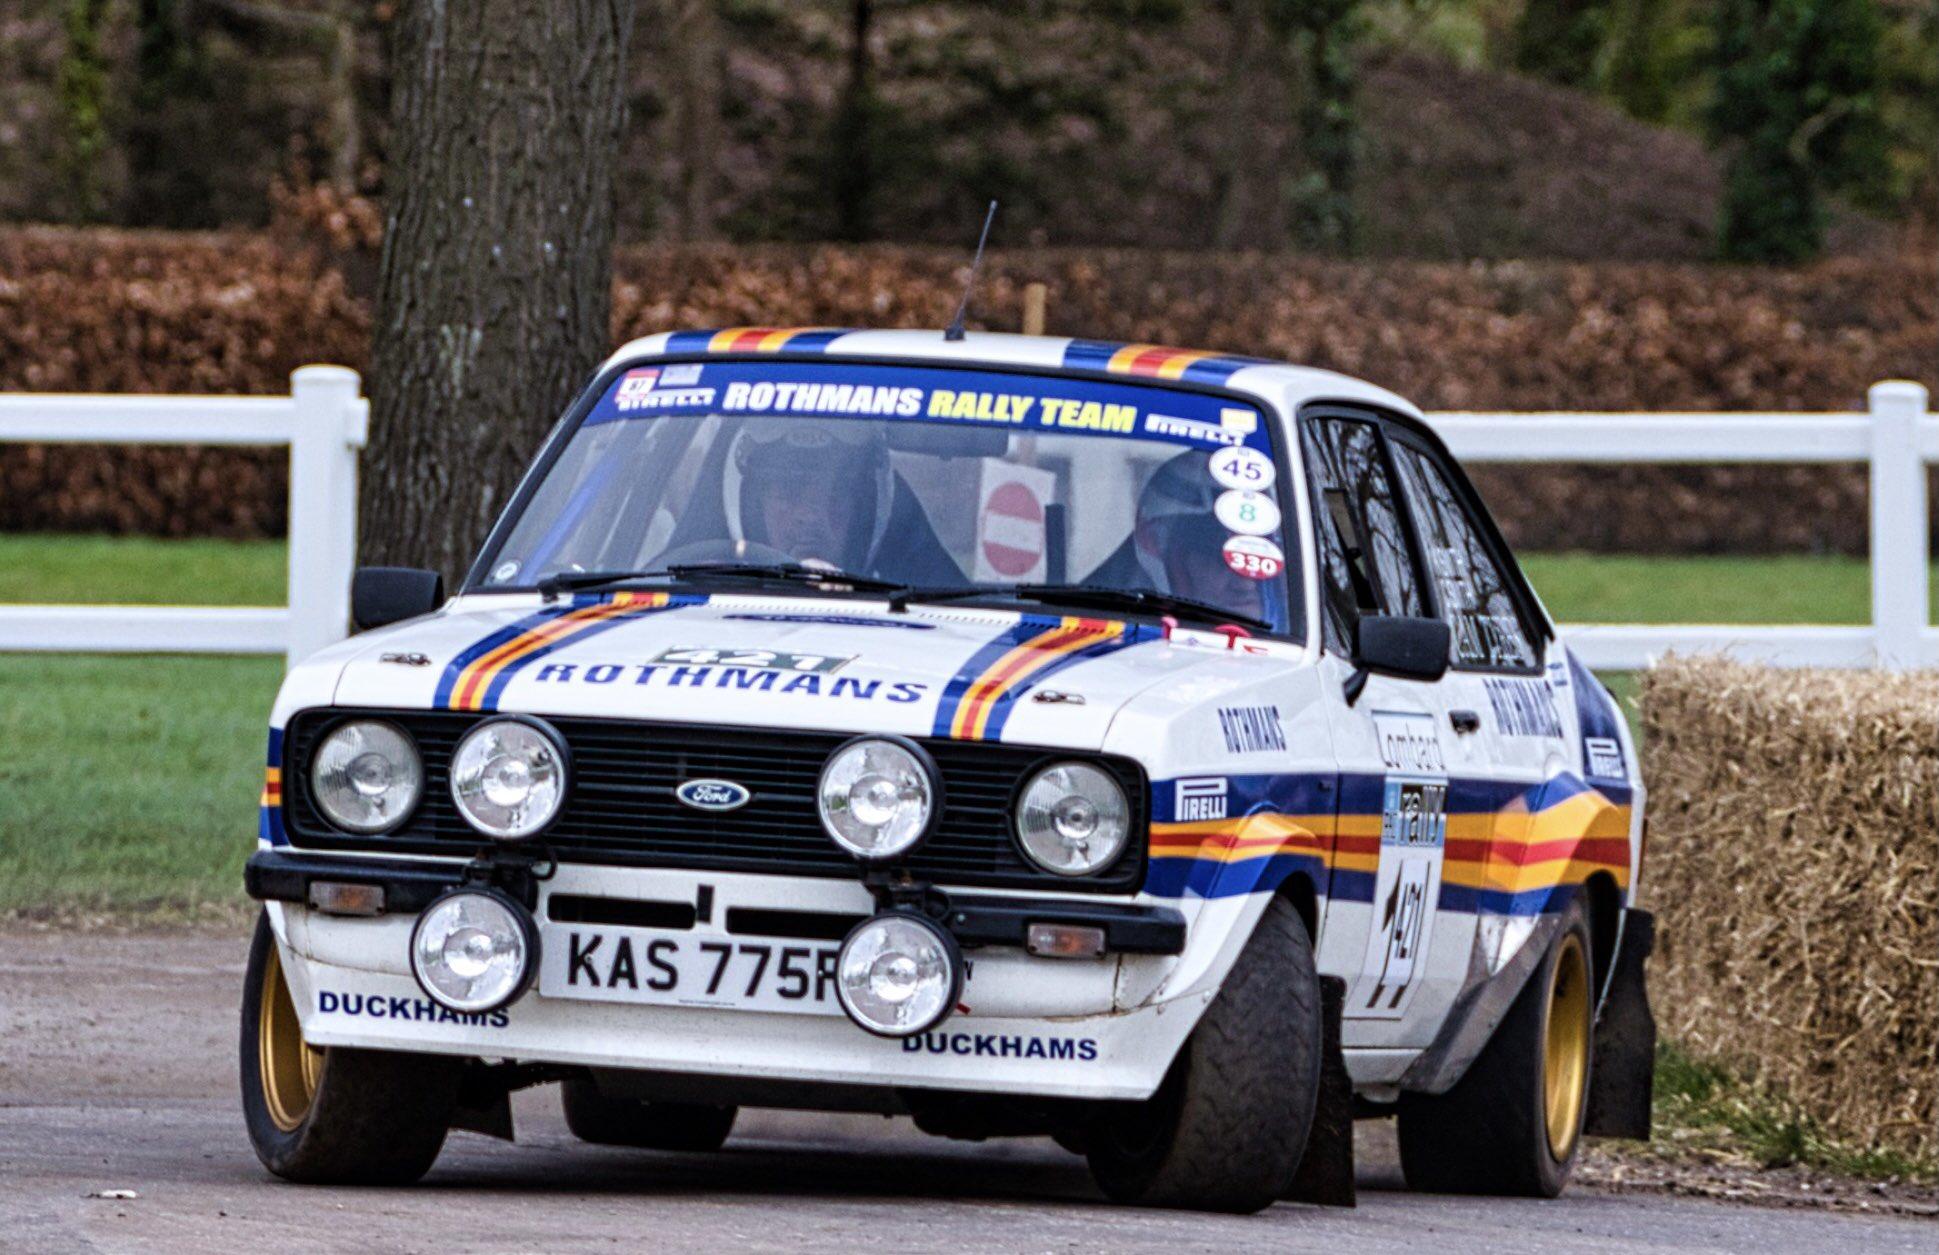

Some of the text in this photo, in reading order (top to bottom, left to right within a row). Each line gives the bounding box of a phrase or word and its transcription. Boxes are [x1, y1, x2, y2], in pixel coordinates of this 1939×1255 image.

[722, 382, 1137, 433] ROTHMANS RALLY TEAM
[1145, 413, 1248, 447] PIRELLI
[1222, 458, 1263, 481] 45
[1238, 503, 1256, 523] 8
[1230, 552, 1278, 577] 330
[662, 647, 829, 672] 421
[535, 663, 929, 703] ROTHMANS
[690, 784, 731, 804] Ford
[1175, 777, 1228, 822] PIRELLI
[567, 933, 679, 991] KAS
[319, 990, 509, 1027] DUCKHAMS
[902, 1034, 1097, 1060] DUCKHAMS
